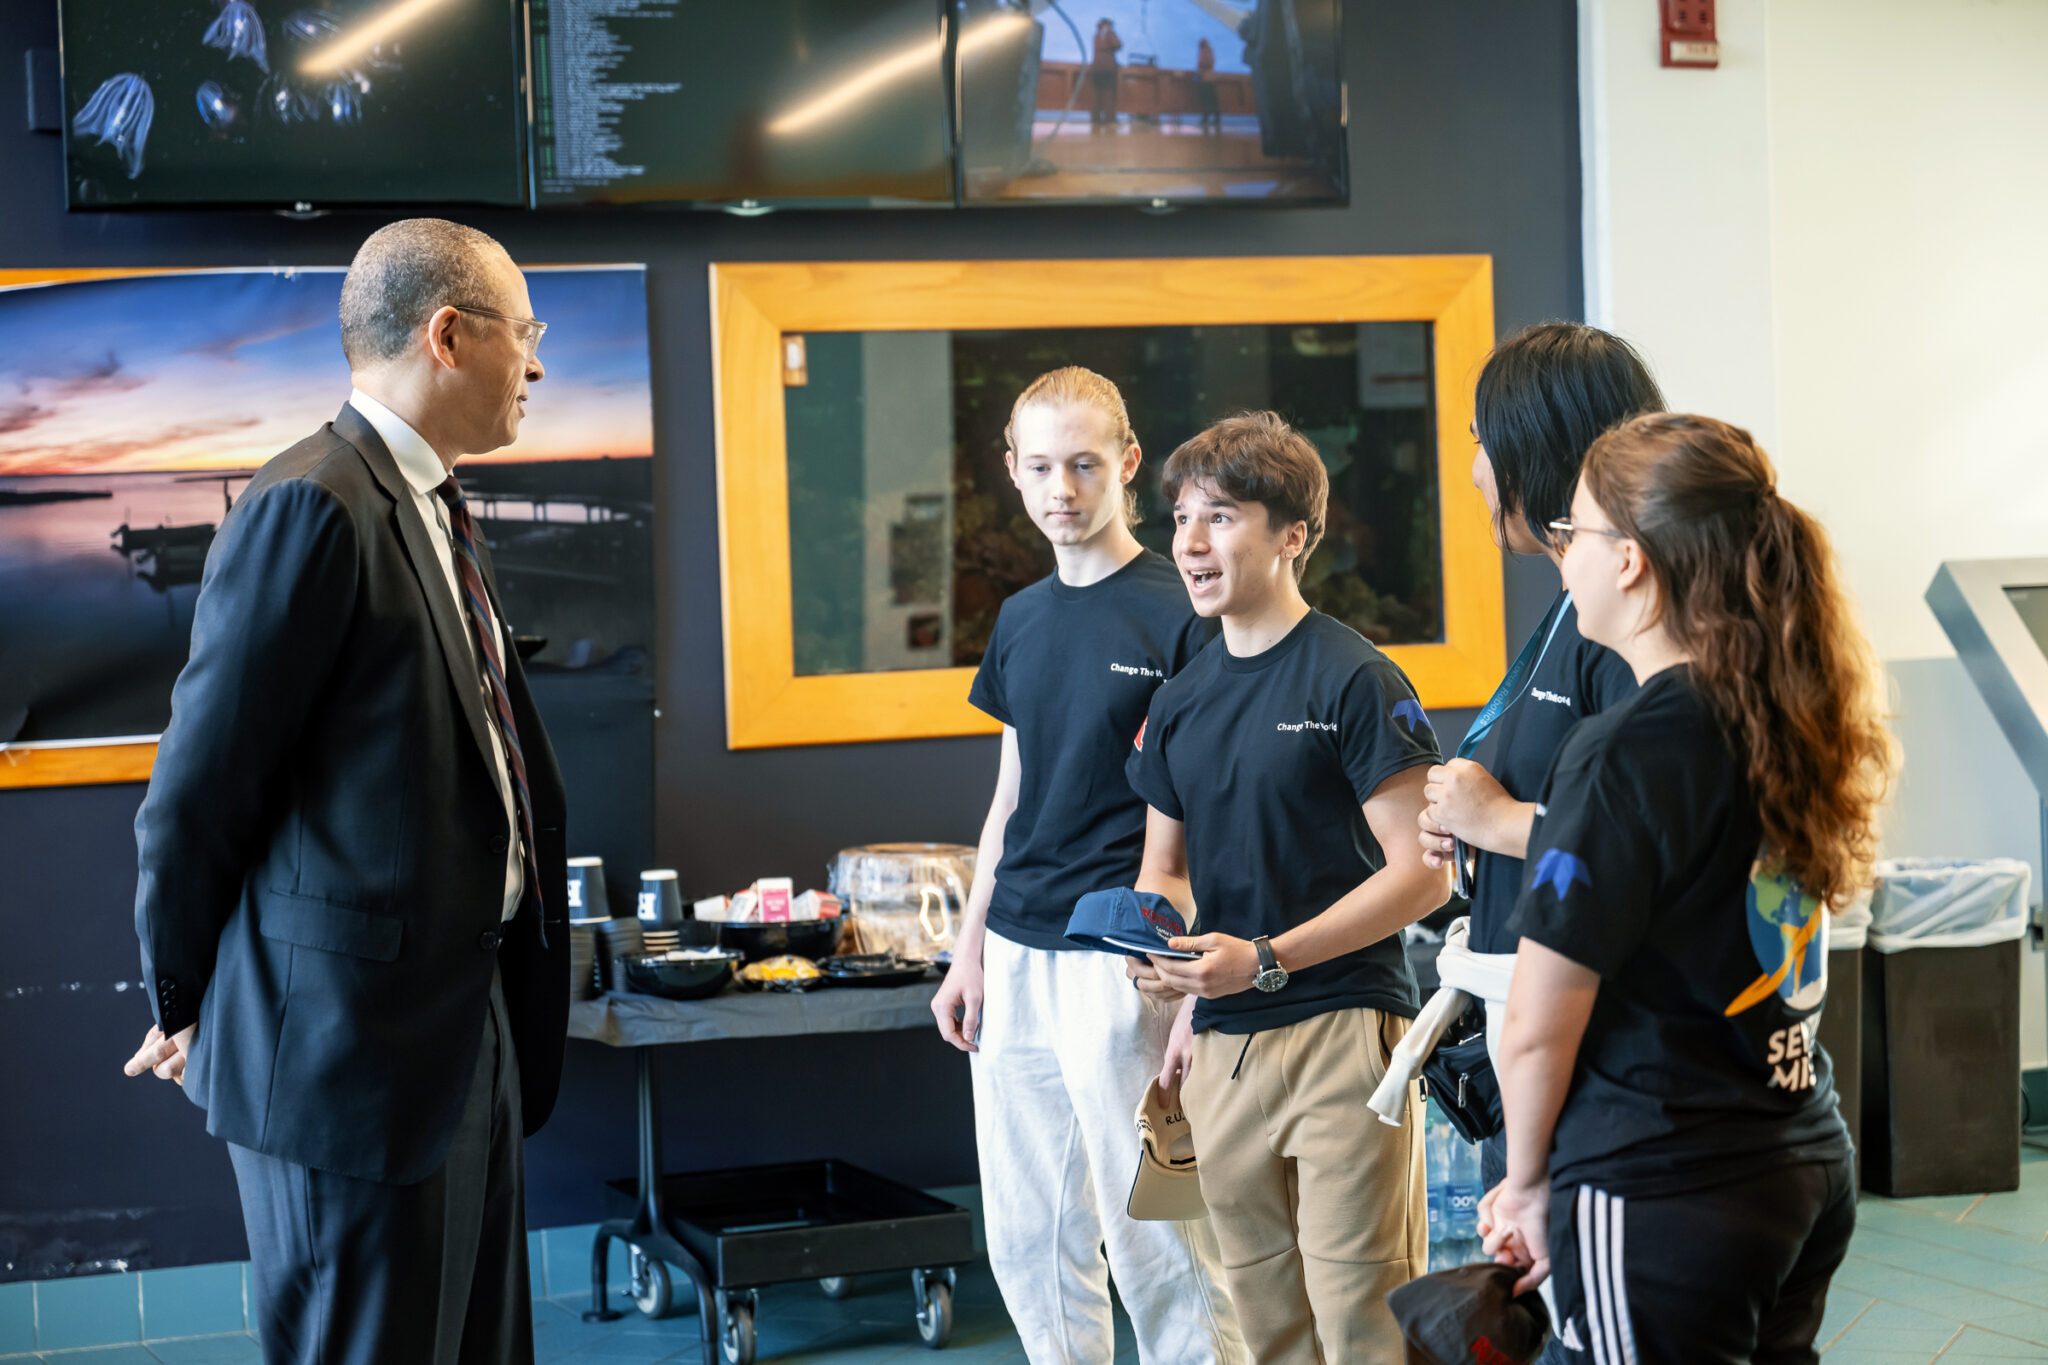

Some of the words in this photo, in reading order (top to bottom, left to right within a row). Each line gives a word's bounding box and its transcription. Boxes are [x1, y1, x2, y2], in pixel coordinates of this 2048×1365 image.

[1110, 662, 1139, 676] Change
[1139, 667, 1155, 677] The
[1479, 687, 1509, 727] Robotics
[1304, 720, 1320, 730] The
[1141, 906, 1184, 936] RUTGER
